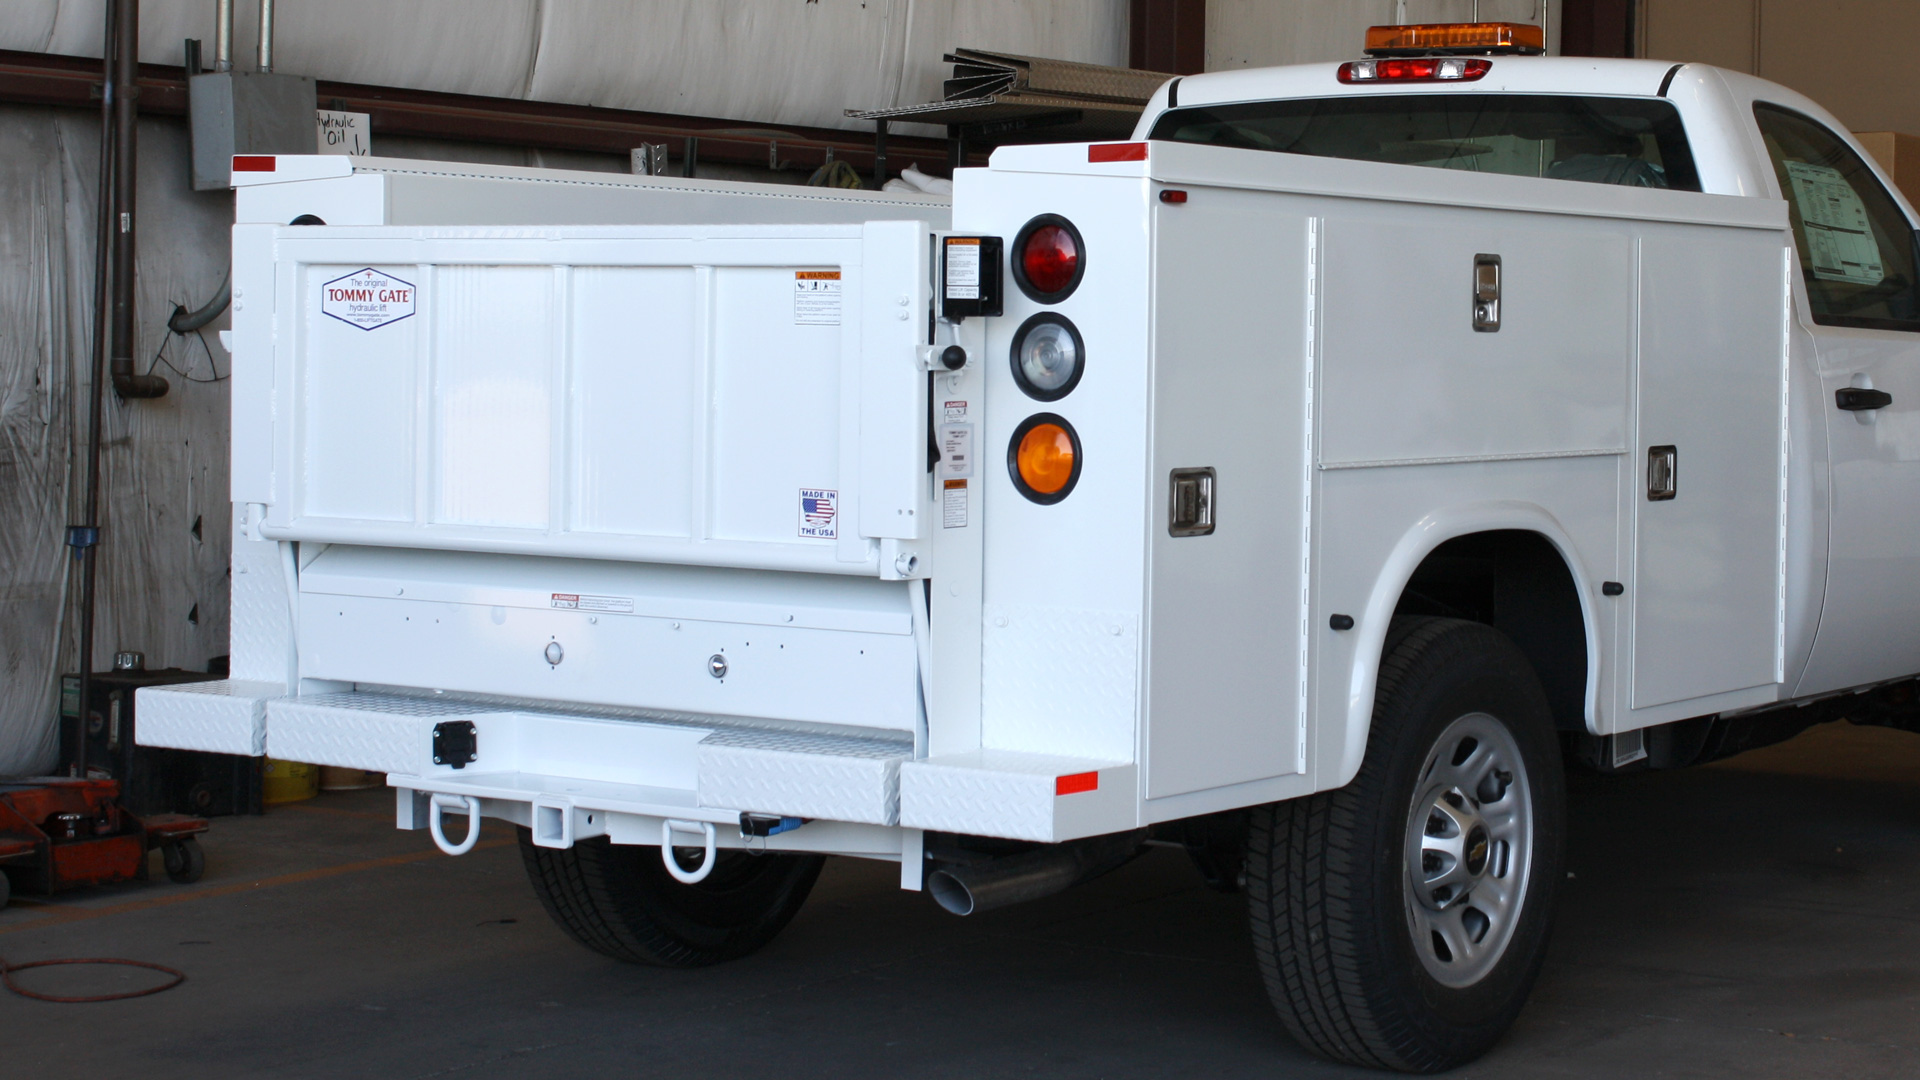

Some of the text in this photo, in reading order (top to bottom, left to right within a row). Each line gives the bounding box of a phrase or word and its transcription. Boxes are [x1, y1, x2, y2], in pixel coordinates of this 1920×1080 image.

[327, 129, 345, 145] Oil
[350, 279, 388, 288] The original
[328, 289, 375, 302] TOMMY
[349, 304, 387, 313] hydraulic lift
[802, 490, 824, 498] MADE
[801, 527, 834, 537] THE USA
